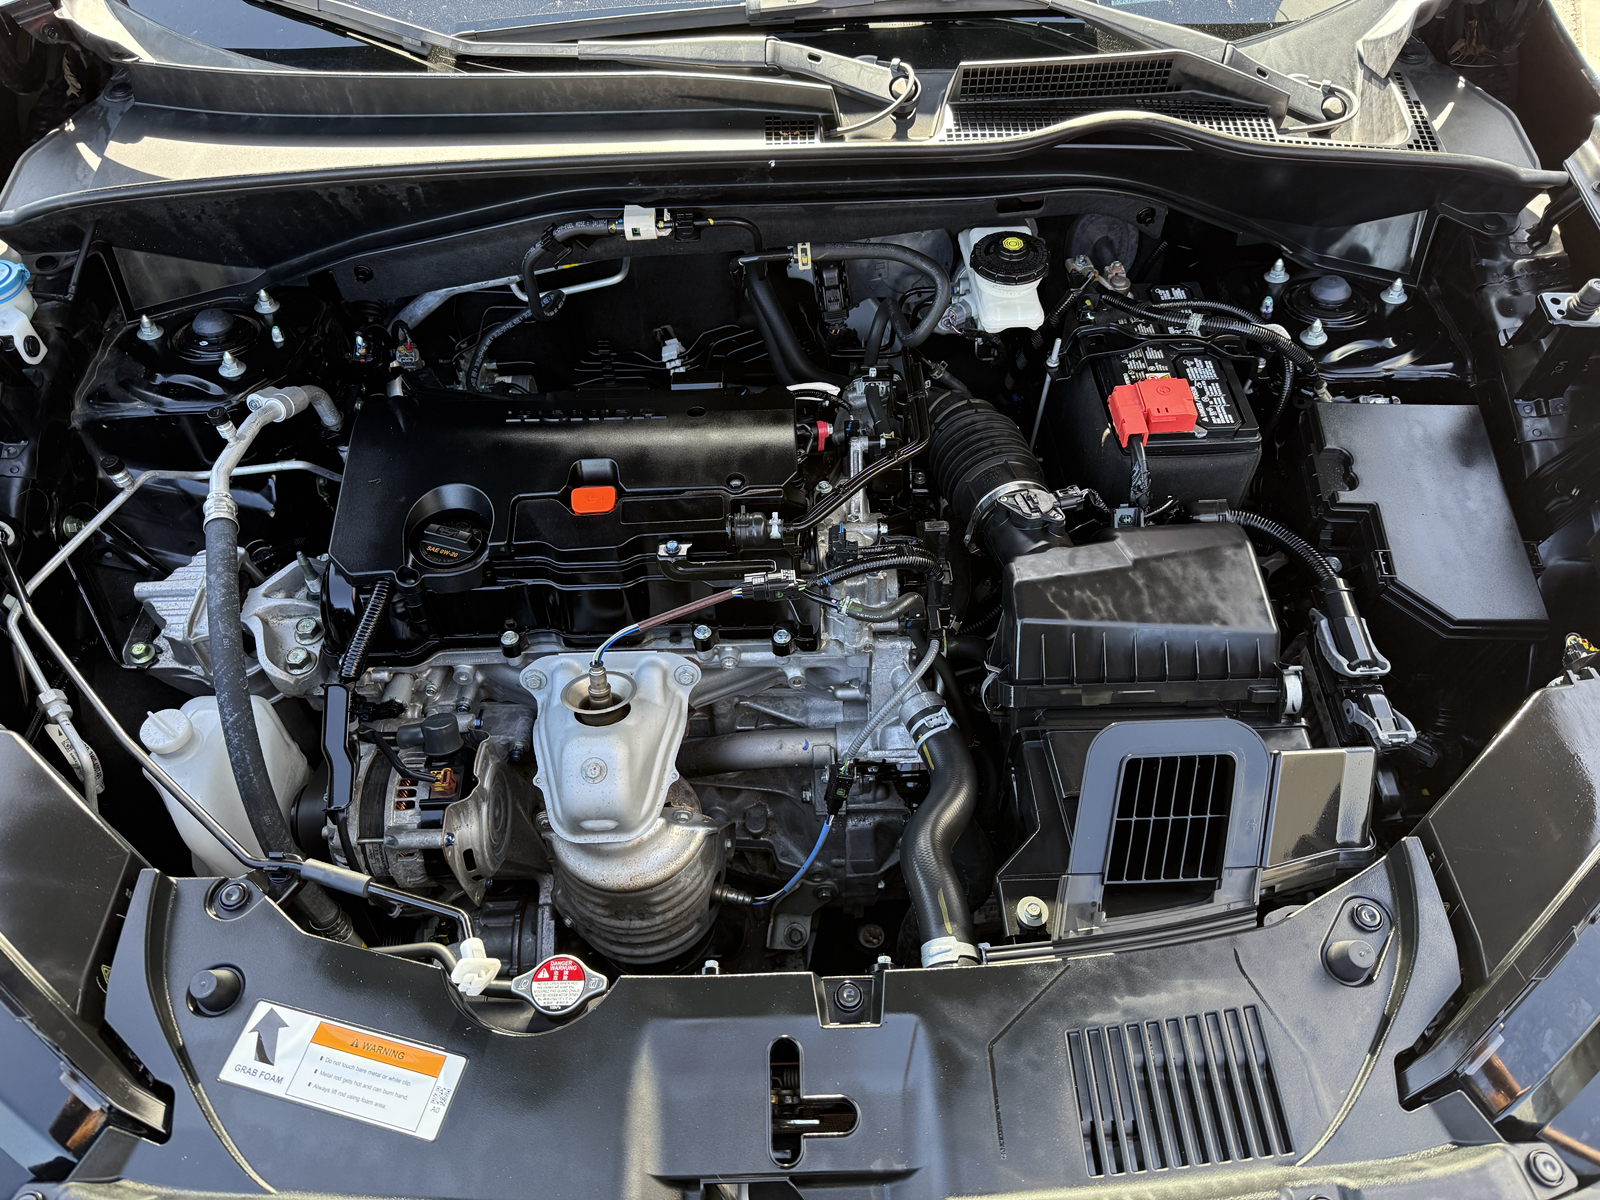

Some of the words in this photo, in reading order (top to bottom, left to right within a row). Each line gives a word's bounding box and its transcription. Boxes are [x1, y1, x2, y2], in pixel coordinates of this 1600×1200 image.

[440, 549, 458, 558] 0W-20
[362, 1042, 405, 1060] WARNING
[234, 1064, 258, 1076] GRAB
[259, 1071, 284, 1084] FOAM
[342, 1061, 355, 1070] touch
[356, 1066, 367, 1074] bare
[368, 1070, 381, 1078] metal
[388, 1075, 401, 1084] white
[402, 1079, 411, 1087] clip.
[313, 1083, 330, 1093] Always
[347, 1093, 360, 1102] using
[361, 1097, 374, 1105] foam
[319, 1070, 333, 1079] Metal
[342, 1077, 353, 1085] gets
[382, 1088, 394, 1097] burn
[395, 1092, 408, 1100] hand.
